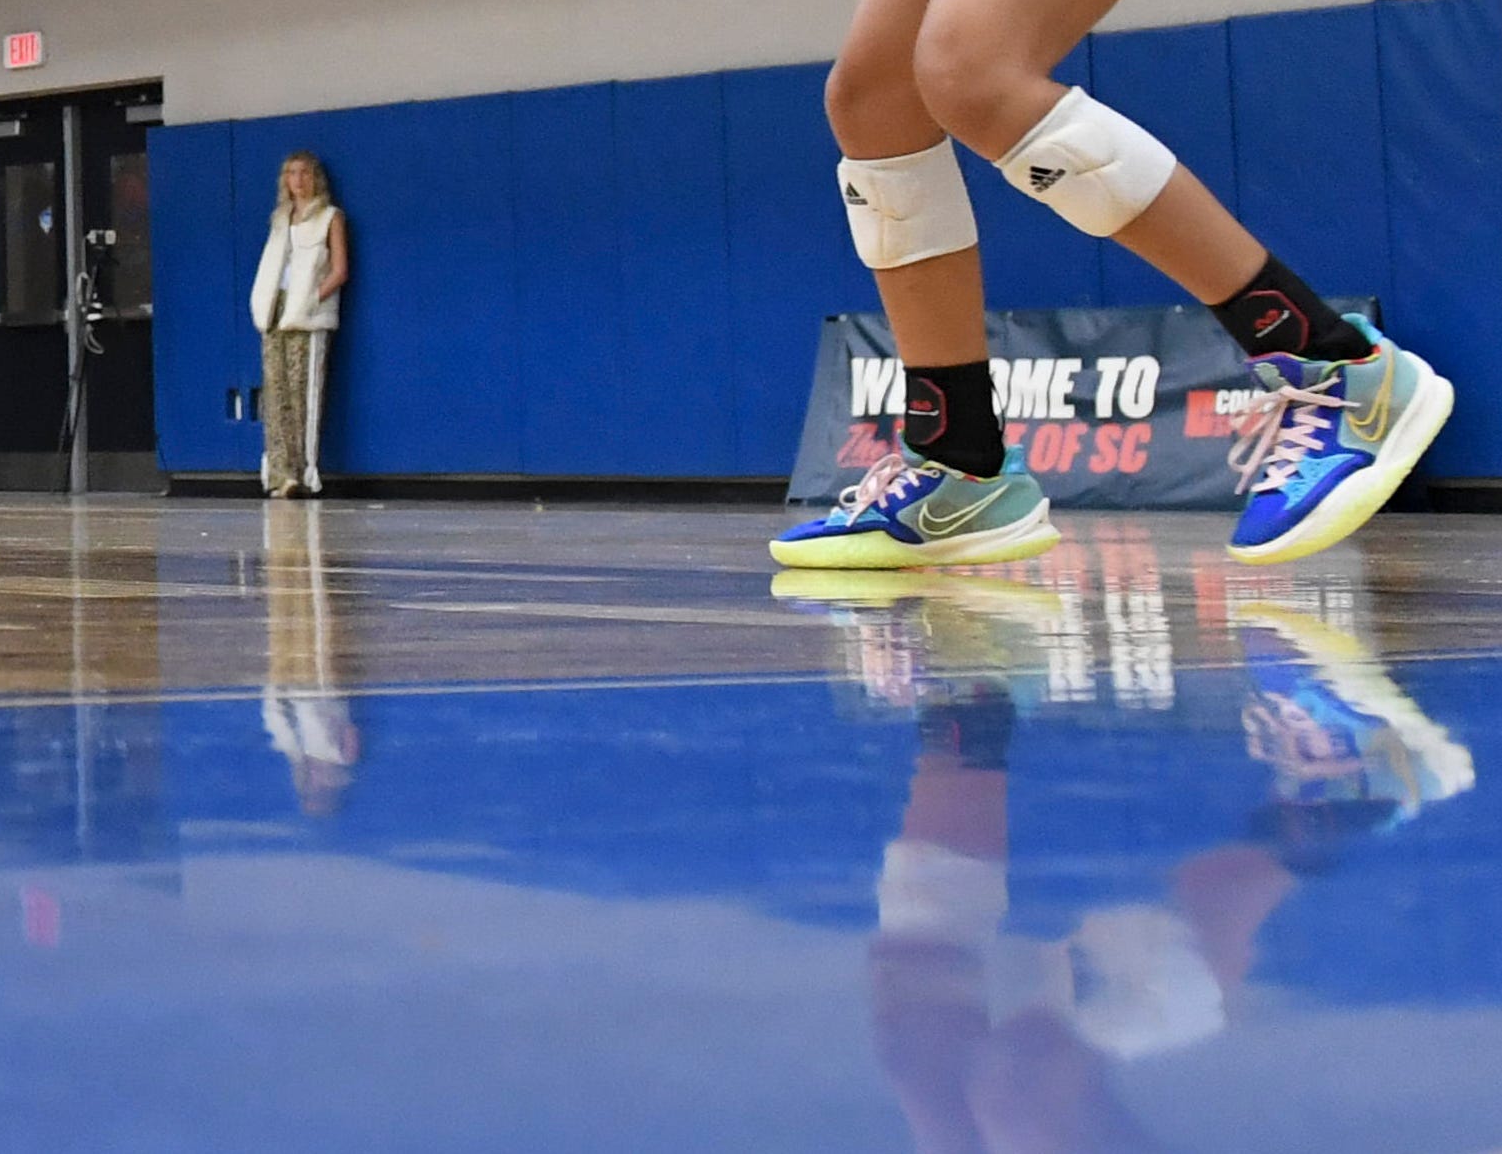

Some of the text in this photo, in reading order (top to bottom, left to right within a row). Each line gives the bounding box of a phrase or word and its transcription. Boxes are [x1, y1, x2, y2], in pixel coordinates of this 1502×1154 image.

[9, 34, 38, 65] EXIT
[1097, 355, 1160, 419] TO
[1028, 423, 1087, 473] OF
[1089, 423, 1152, 474] SC
